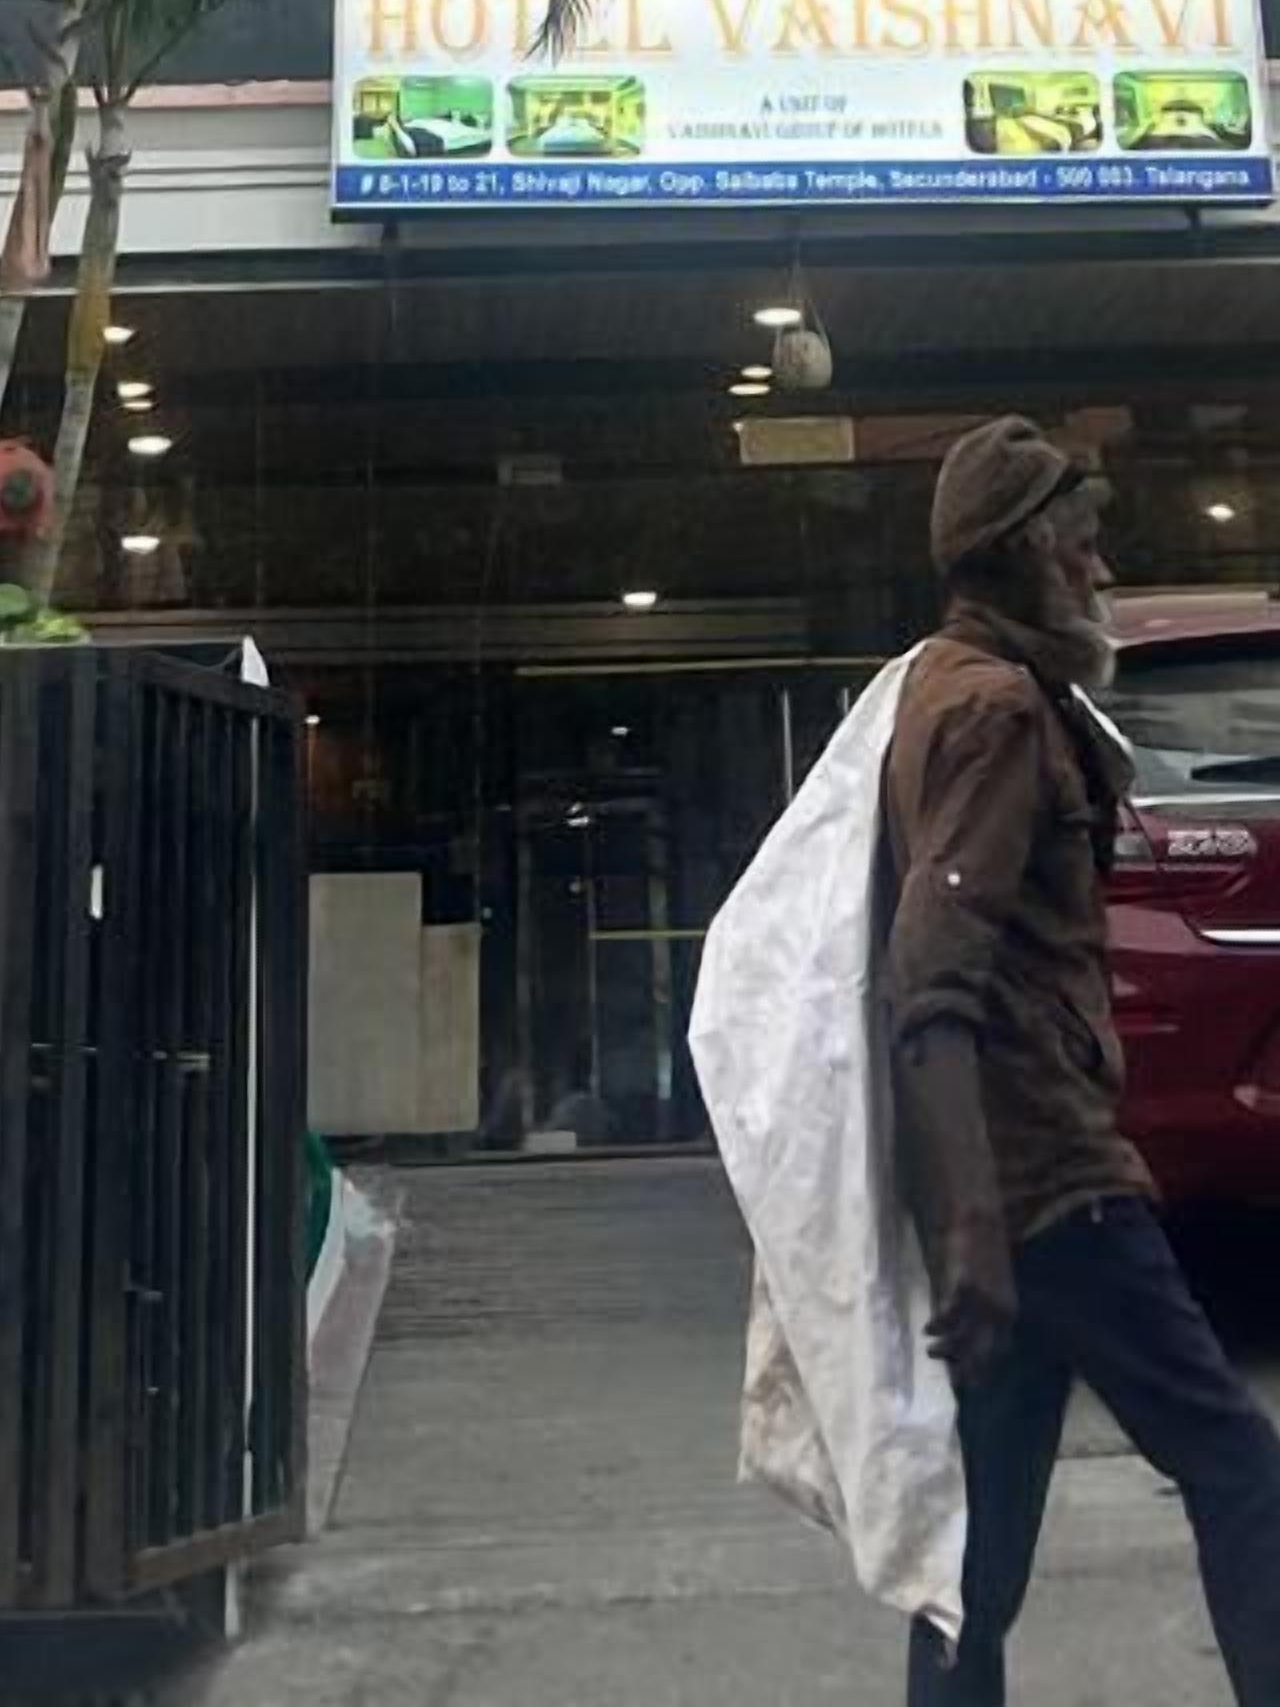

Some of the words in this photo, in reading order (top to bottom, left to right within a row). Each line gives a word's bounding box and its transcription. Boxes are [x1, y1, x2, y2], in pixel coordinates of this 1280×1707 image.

[447, 174, 470, 193] to
[511, 170, 581, 196] Shivaji
[889, 167, 1038, 189] Secunderabad
